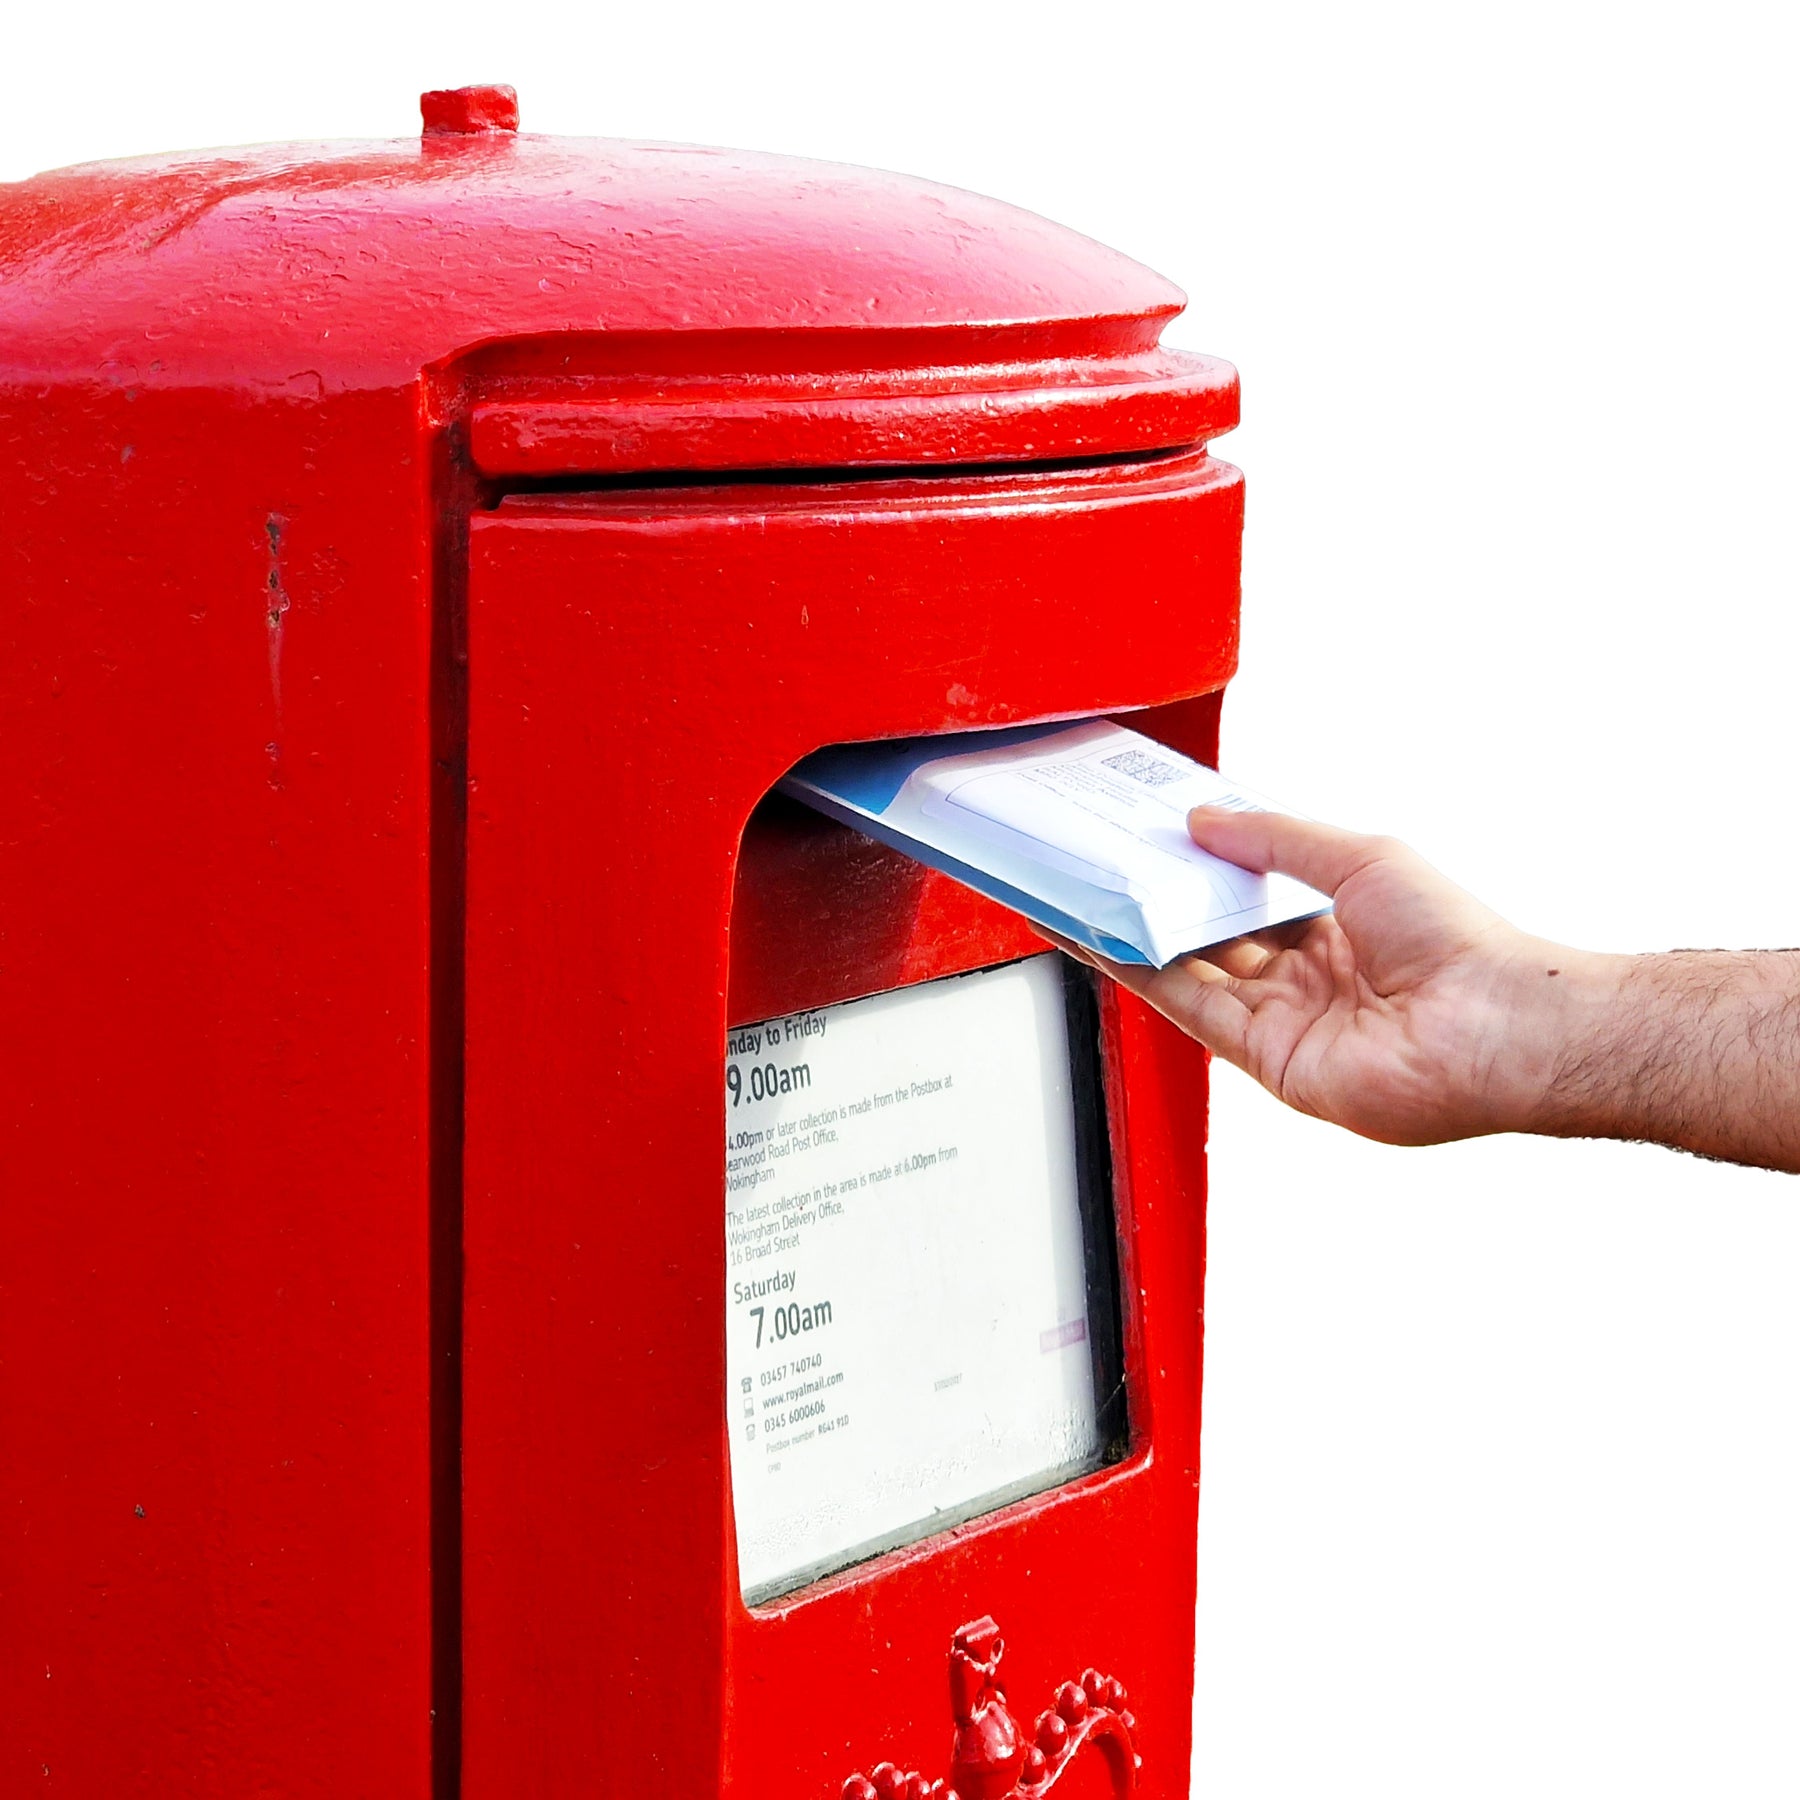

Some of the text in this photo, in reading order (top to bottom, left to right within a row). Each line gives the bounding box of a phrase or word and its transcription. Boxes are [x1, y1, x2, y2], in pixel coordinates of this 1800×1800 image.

[766, 1028, 780, 1046] to
[784, 1015, 827, 1041] Friday
[727, 1063, 811, 1107] 9.00am
[729, 1075, 954, 1151] 4.00pm or later collection is made from the Postbox at
[768, 1143, 790, 1159] Road
[793, 1137, 811, 1150] Post
[813, 1130, 839, 1145] Office,
[728, 1146, 958, 1228] The latest collection in the area is made at 6.00pm from
[728, 1202, 844, 1247] Wokingham Delivery Office,
[730, 1233, 800, 1266] 16 Broad Street
[734, 1268, 797, 1304] Saturday
[749, 1299, 833, 1349] 7.00am
[760, 1353, 822, 1386] 03457 740740
[762, 1372, 844, 1409] www.royalmail.com
[764, 1399, 826, 1433] 0345 6000606
[766, 1439, 790, 1454] Postbox
